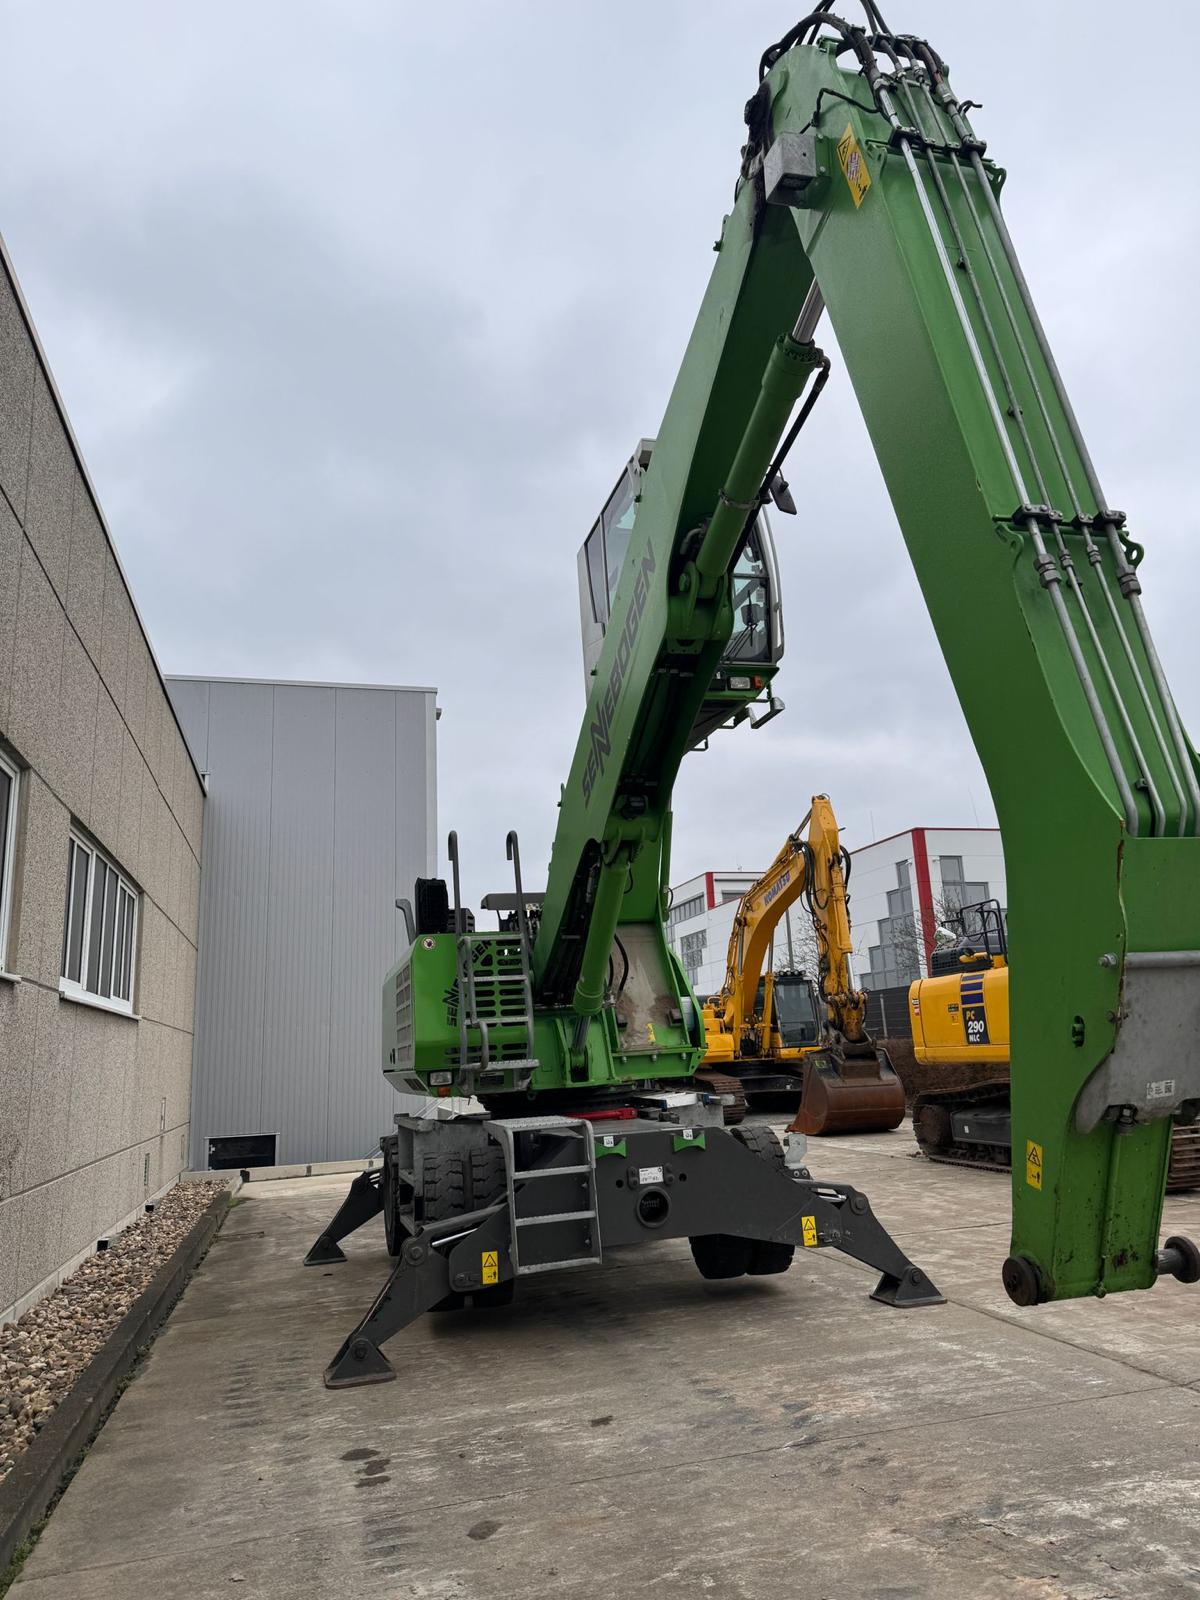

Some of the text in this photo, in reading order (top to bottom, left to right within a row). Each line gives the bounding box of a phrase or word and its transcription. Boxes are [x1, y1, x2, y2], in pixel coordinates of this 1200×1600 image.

[582, 536, 656, 809] SENNEBOGEN
[764, 870, 791, 907] KOMATSU
[966, 1010, 975, 1020] PC
[967, 1020, 985, 1034] 290
[968, 1034, 980, 1042] NLC
